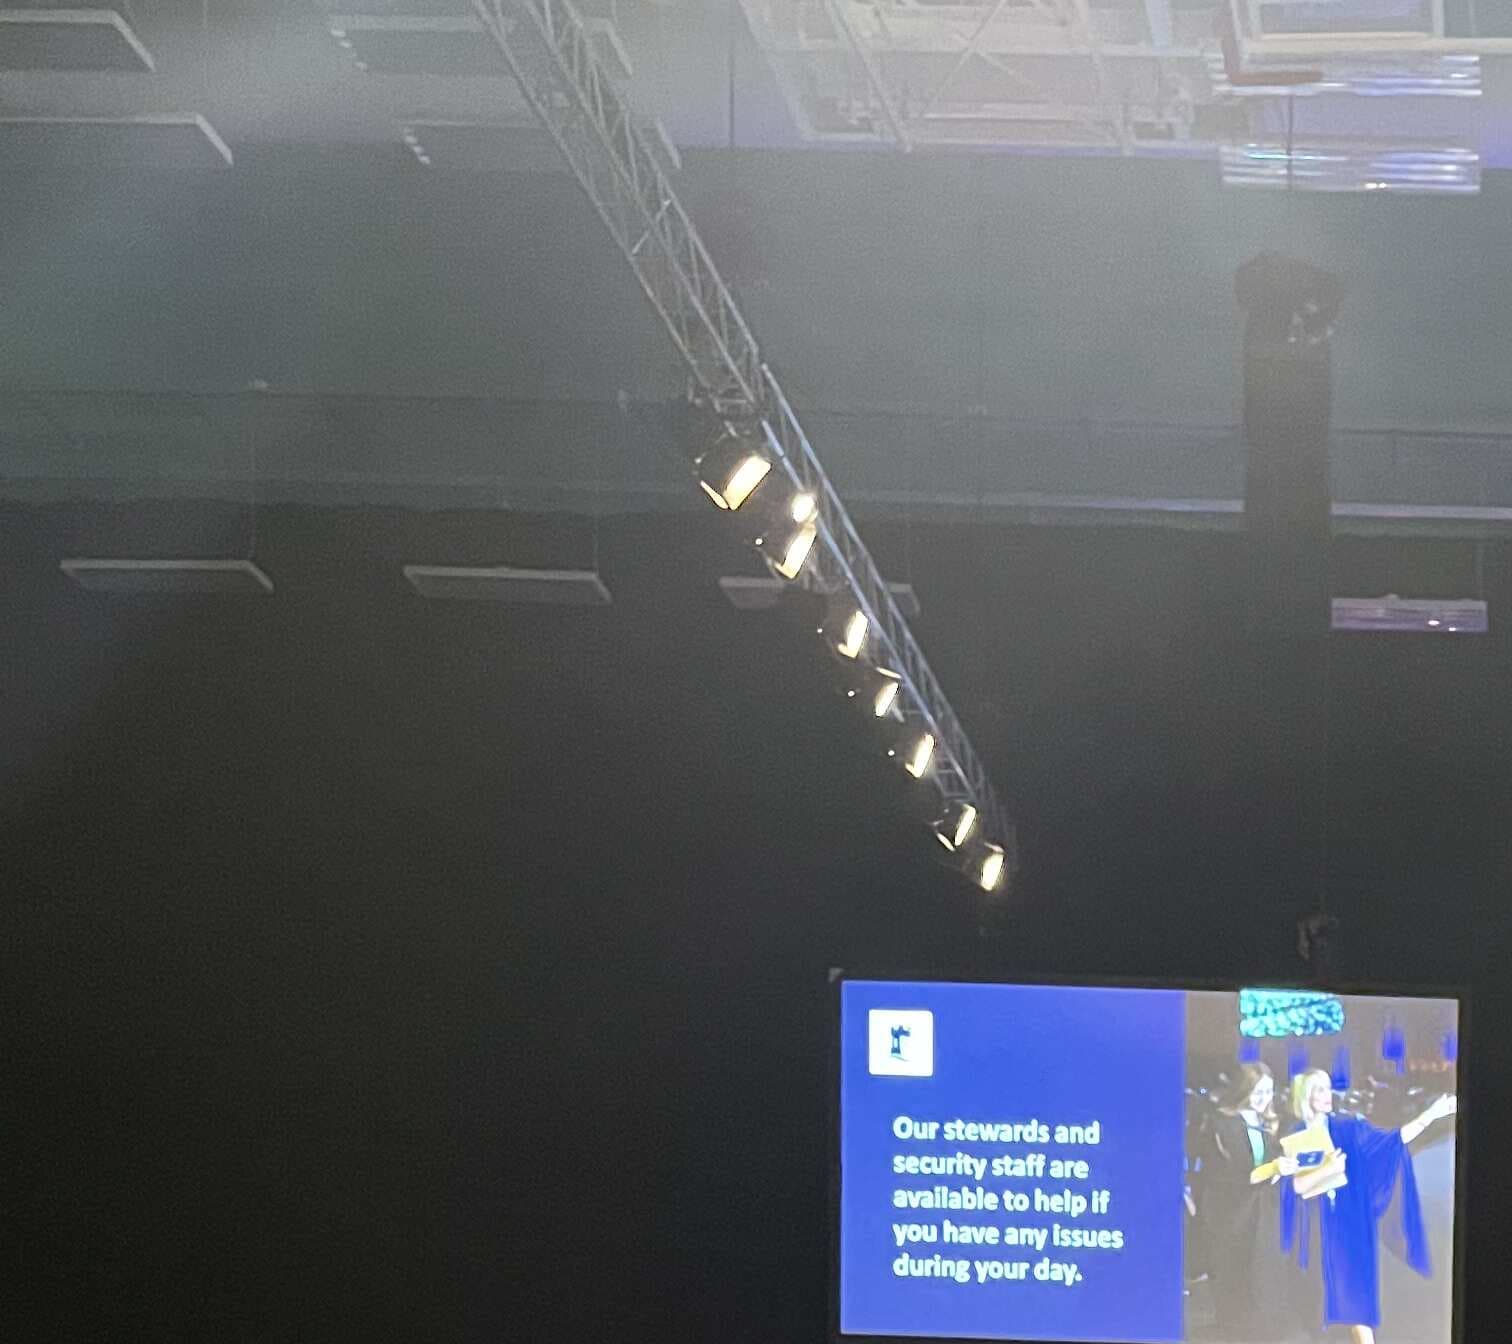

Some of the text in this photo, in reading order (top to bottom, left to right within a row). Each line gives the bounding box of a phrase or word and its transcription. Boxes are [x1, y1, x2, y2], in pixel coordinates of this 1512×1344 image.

[893, 1116, 1100, 1144] Our stewards and
[893, 1152, 1089, 1180] security staff are
[893, 1186, 1110, 1217] available to help if
[893, 1220, 1123, 1250] you have any issues
[893, 1253, 1082, 1286] during your day.
